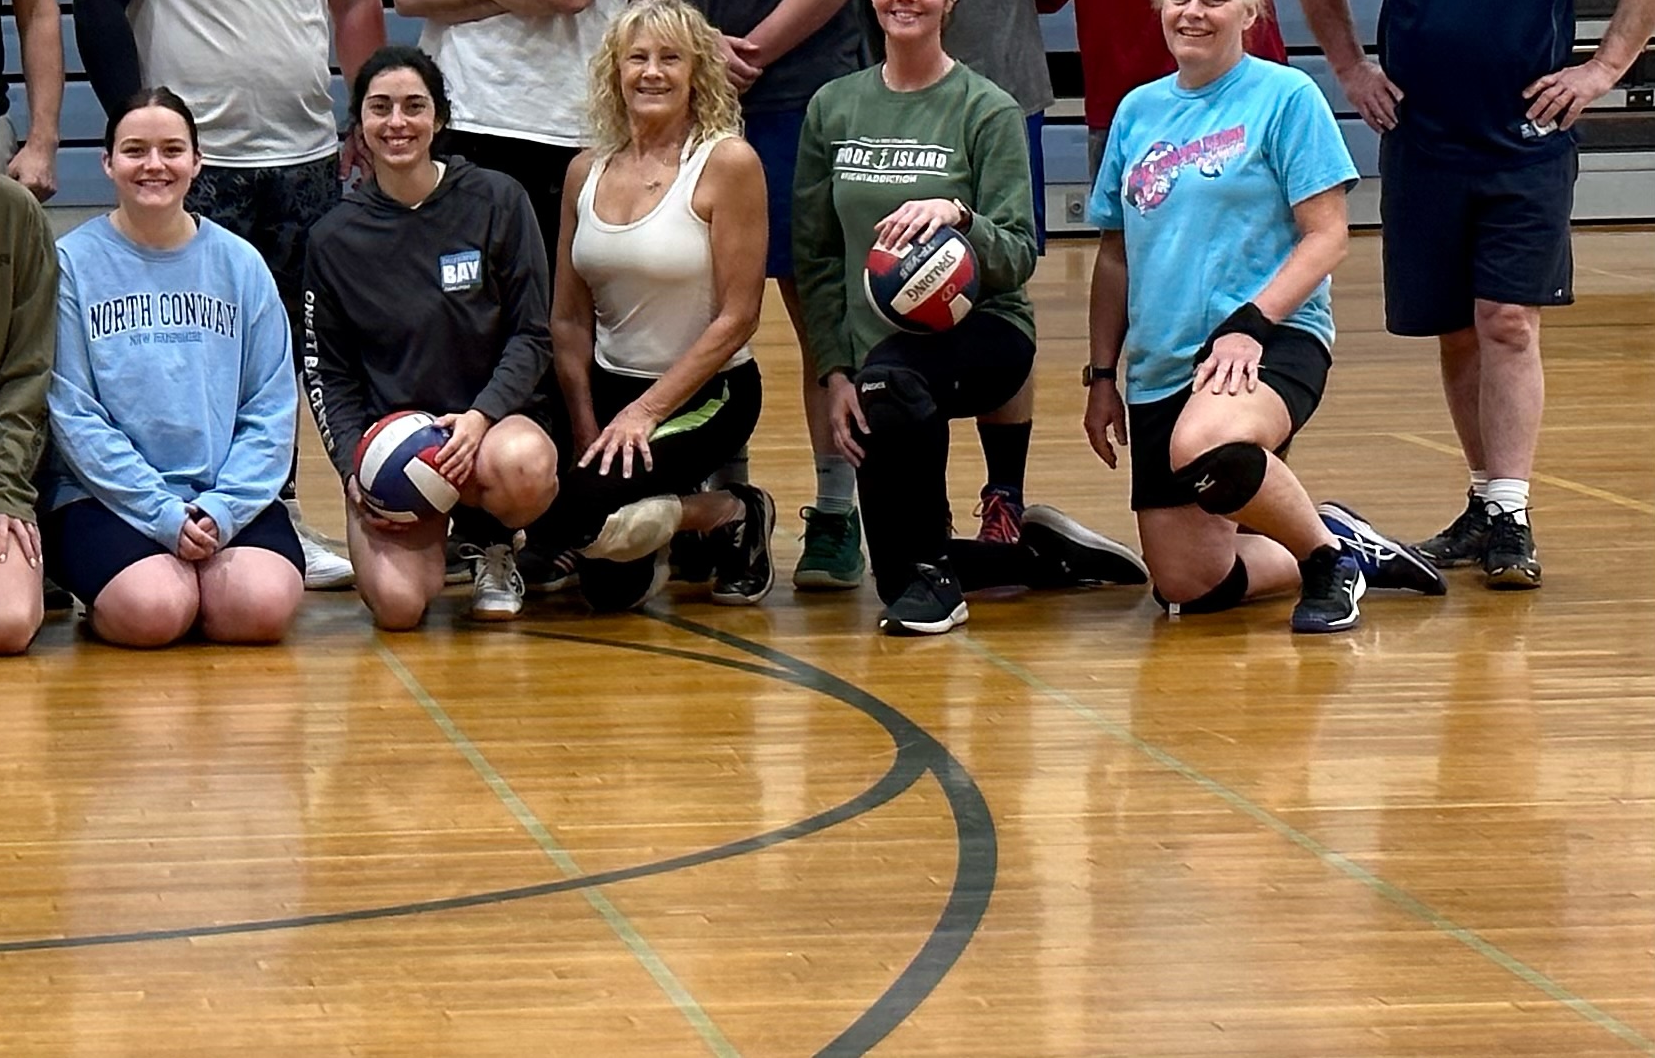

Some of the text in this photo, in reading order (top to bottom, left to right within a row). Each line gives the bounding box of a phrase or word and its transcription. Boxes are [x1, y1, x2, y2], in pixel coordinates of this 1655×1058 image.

[892, 150, 947, 169] ISLAND
[442, 260, 480, 284] BAY
[904, 249, 957, 303] SPALDING
[90, 292, 238, 341] NORTH CONWAY
[303, 289, 319, 354] ONSET
[303, 355, 325, 388] BAY
